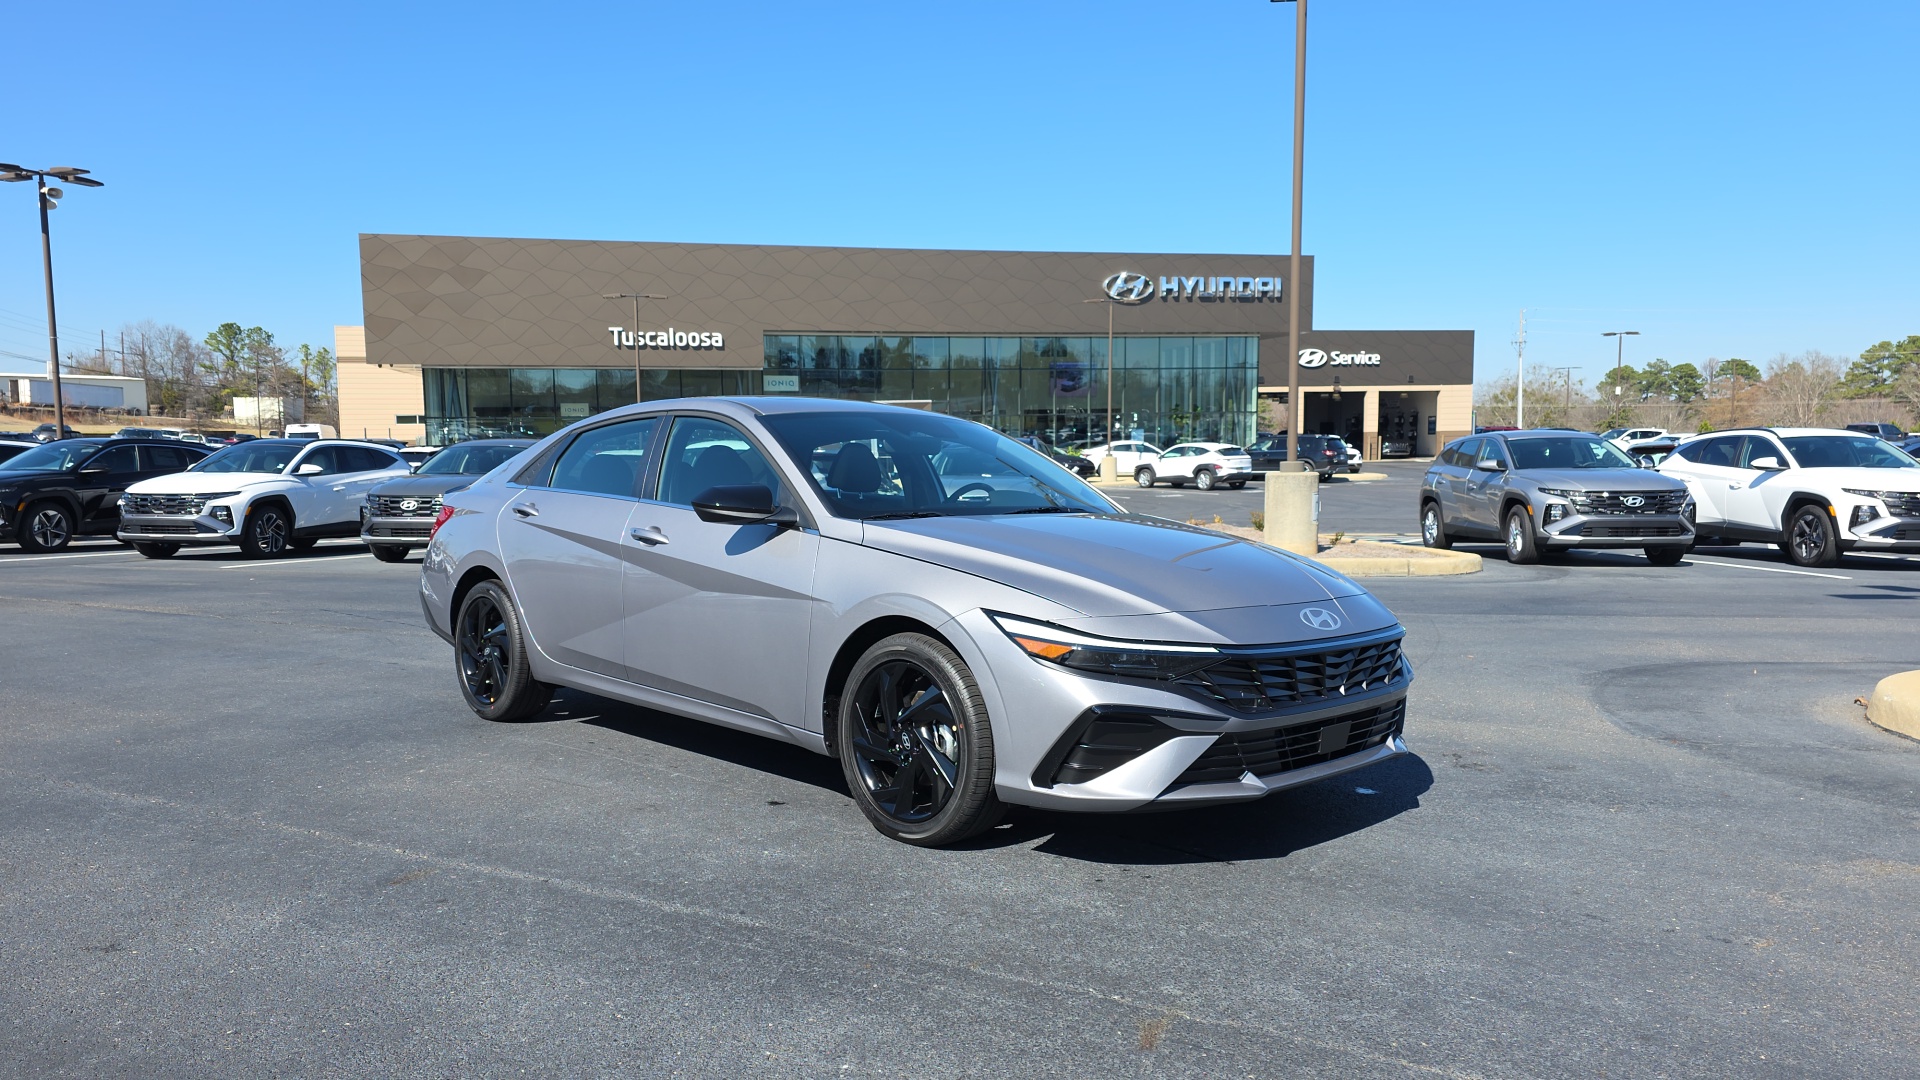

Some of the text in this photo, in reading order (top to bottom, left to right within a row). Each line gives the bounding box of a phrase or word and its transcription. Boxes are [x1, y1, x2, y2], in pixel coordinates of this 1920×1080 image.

[1159, 276, 1282, 297] HYUNDAI
[608, 327, 723, 347] Tuscaloosa
[1330, 350, 1381, 365] Service
